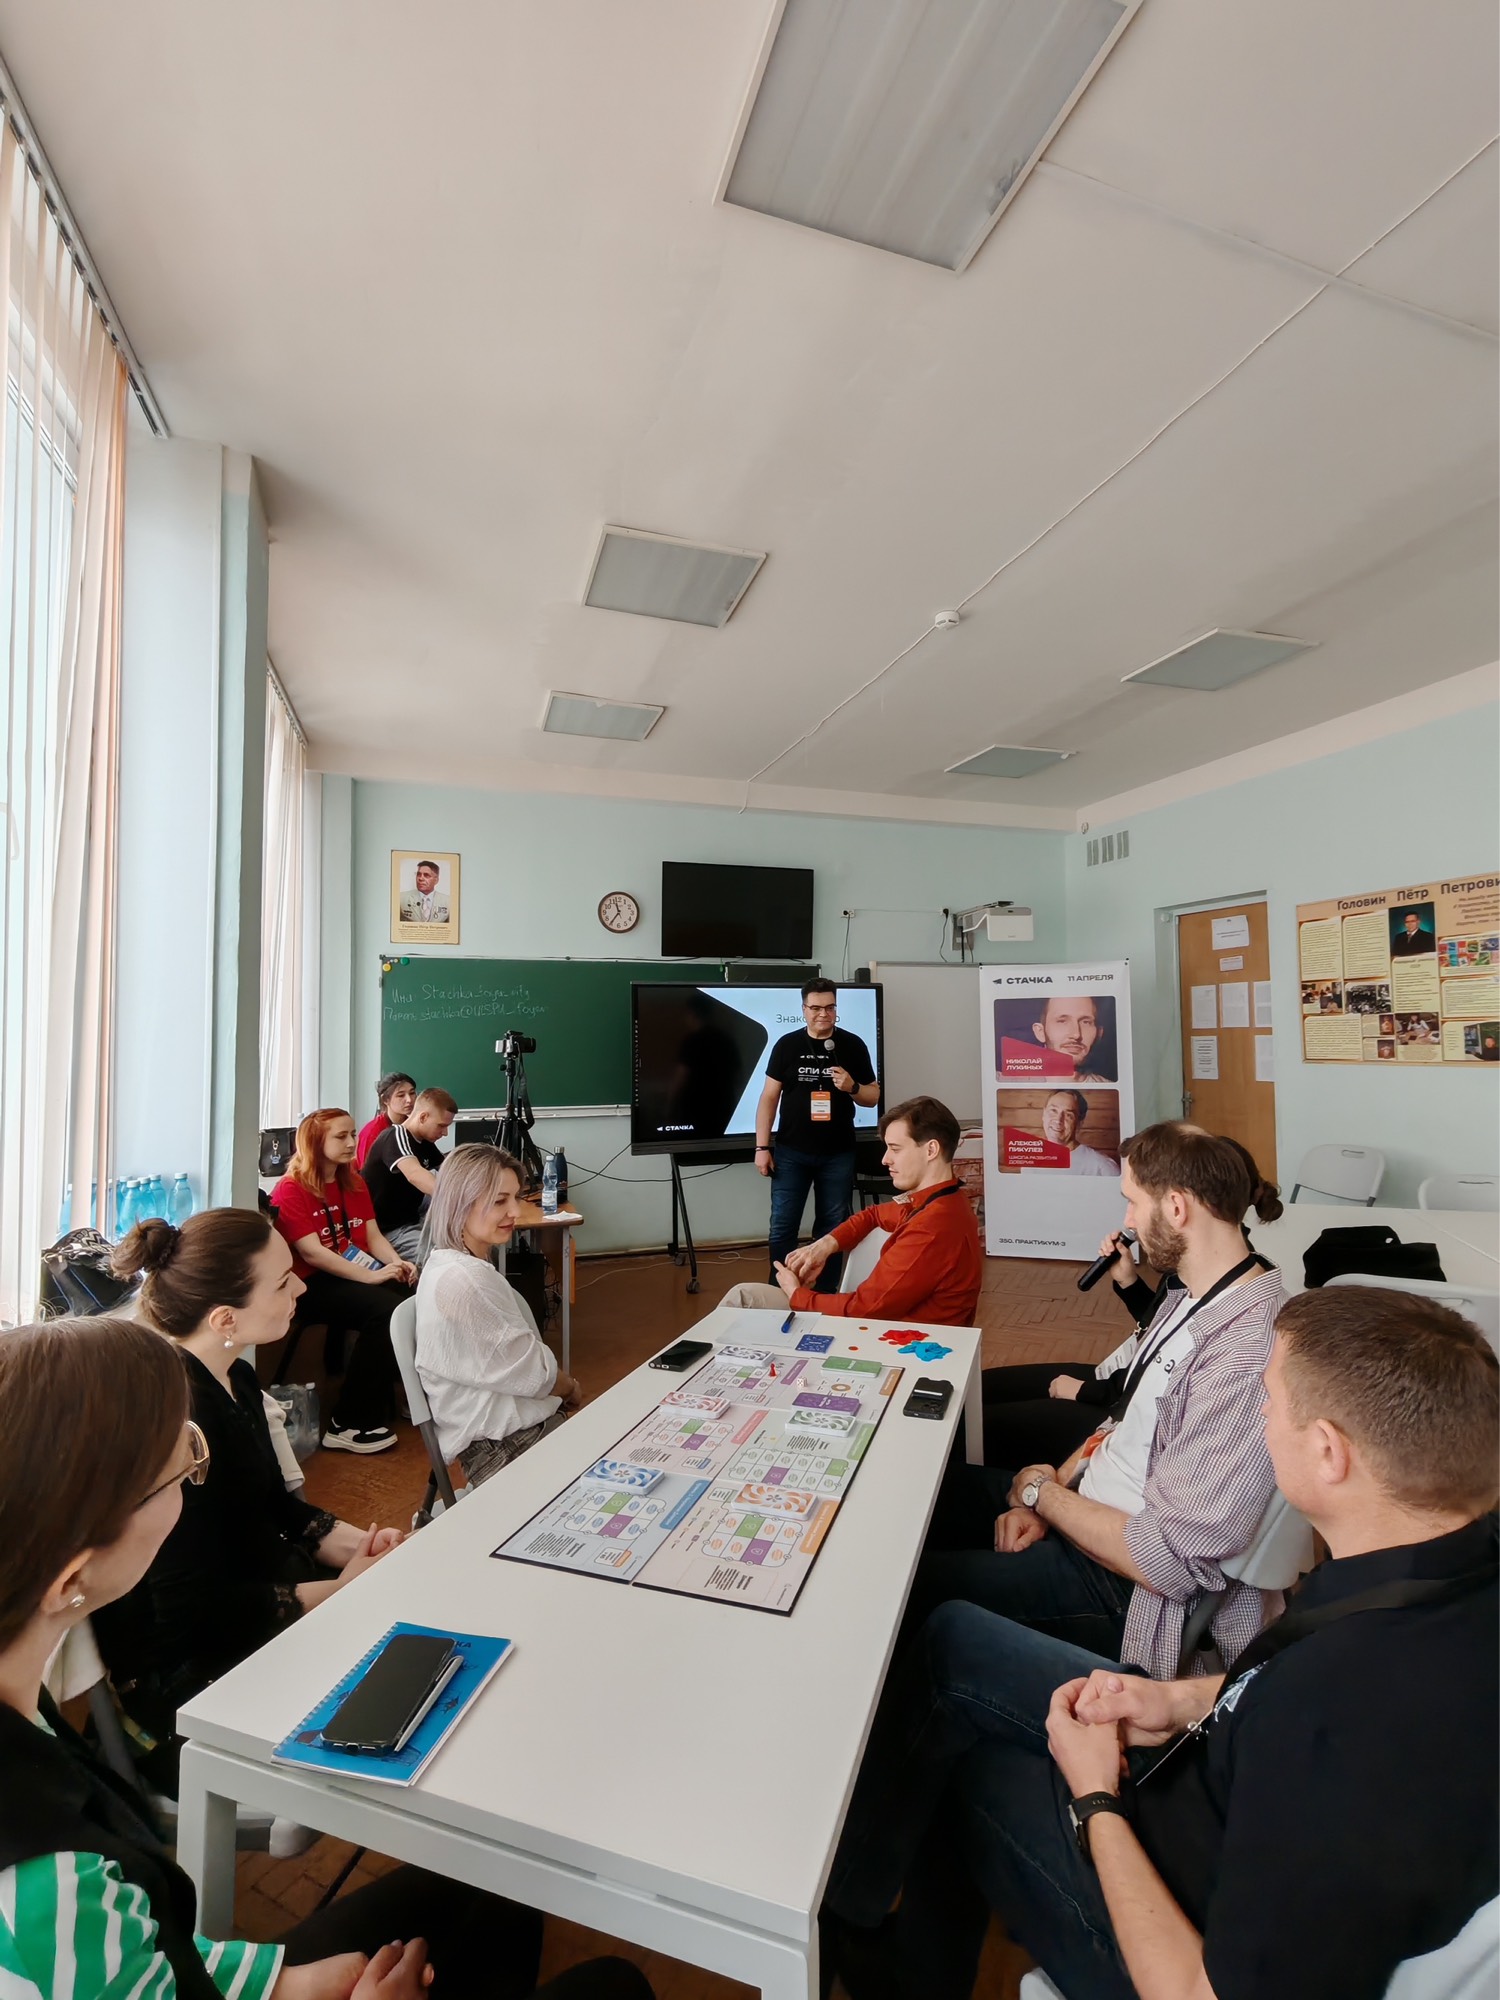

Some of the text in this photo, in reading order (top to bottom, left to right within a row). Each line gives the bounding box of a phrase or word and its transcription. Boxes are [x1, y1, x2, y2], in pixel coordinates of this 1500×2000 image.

[1337, 896, 1386, 911] Головин
[1397, 888, 1429, 901] Пётр
[1006, 976, 1053, 984] СТАЧКА
[1076, 974, 1114, 982] АПРЕЛЯ
[798, 1067, 832, 1075] СПИКЕ
[665, 1124, 694, 1132] СТАЧКА
[1015, 1238, 1067, 1247] ПРАКТИКУМ-3
